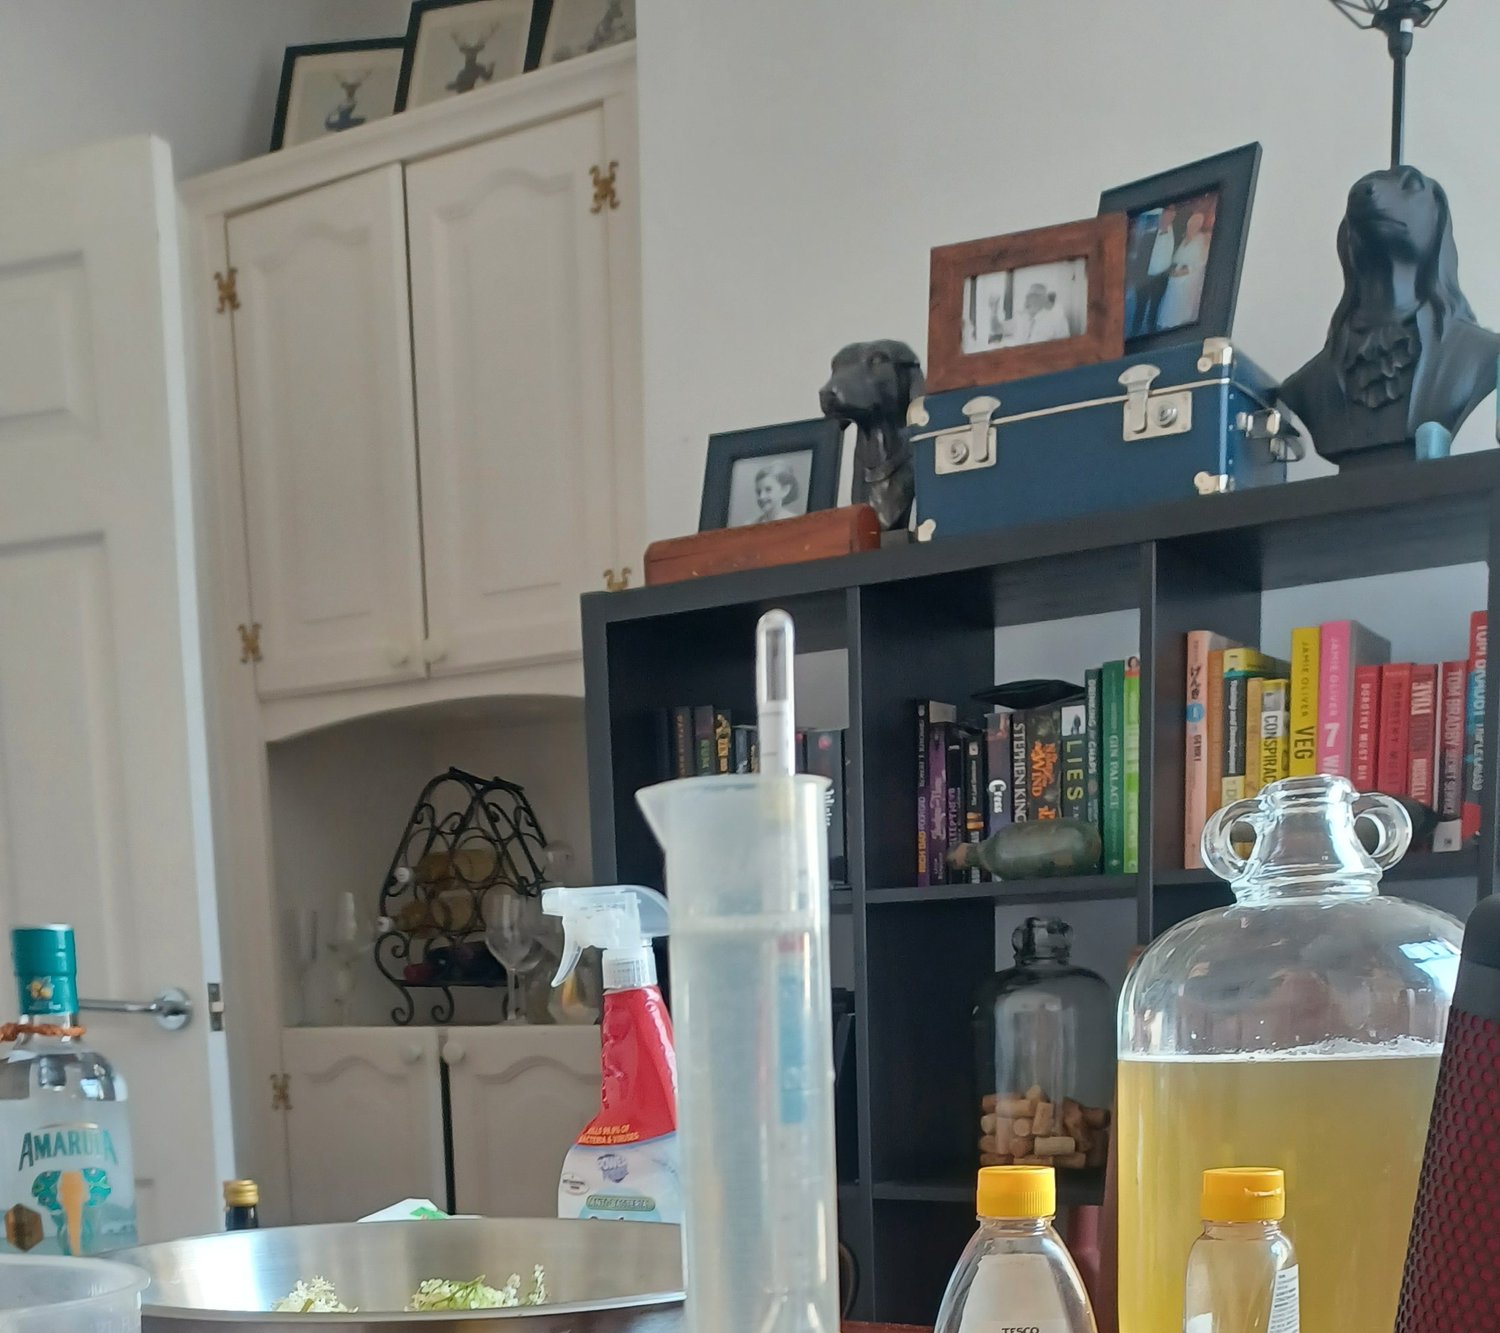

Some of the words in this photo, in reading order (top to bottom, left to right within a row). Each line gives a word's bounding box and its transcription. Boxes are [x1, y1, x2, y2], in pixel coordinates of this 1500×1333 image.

[1301, 641, 1310, 674] JAMIE
[1329, 638, 1340, 673] JAMIE
[1301, 677, 1310, 718] OLIVER
[1328, 674, 1340, 717] OLIVER
[1446, 669, 1463, 697] TOM
[1088, 679, 1097, 728] DRINKING
[1359, 683, 1372, 730] DOROTHY
[1445, 698, 1462, 746] BRADBY
[1109, 735, 1119, 757] GIN
[1294, 725, 1315, 760] VEG
[1324, 722, 1341, 748] 7
[1013, 723, 1027, 785] STEPHEN
[1066, 740, 1084, 801] LIES
[1088, 740, 1097, 775] CHAPS
[988, 779, 1007, 813] Cress
[1109, 761, 1119, 810] PALACE
[1014, 787, 1028, 824] KING
